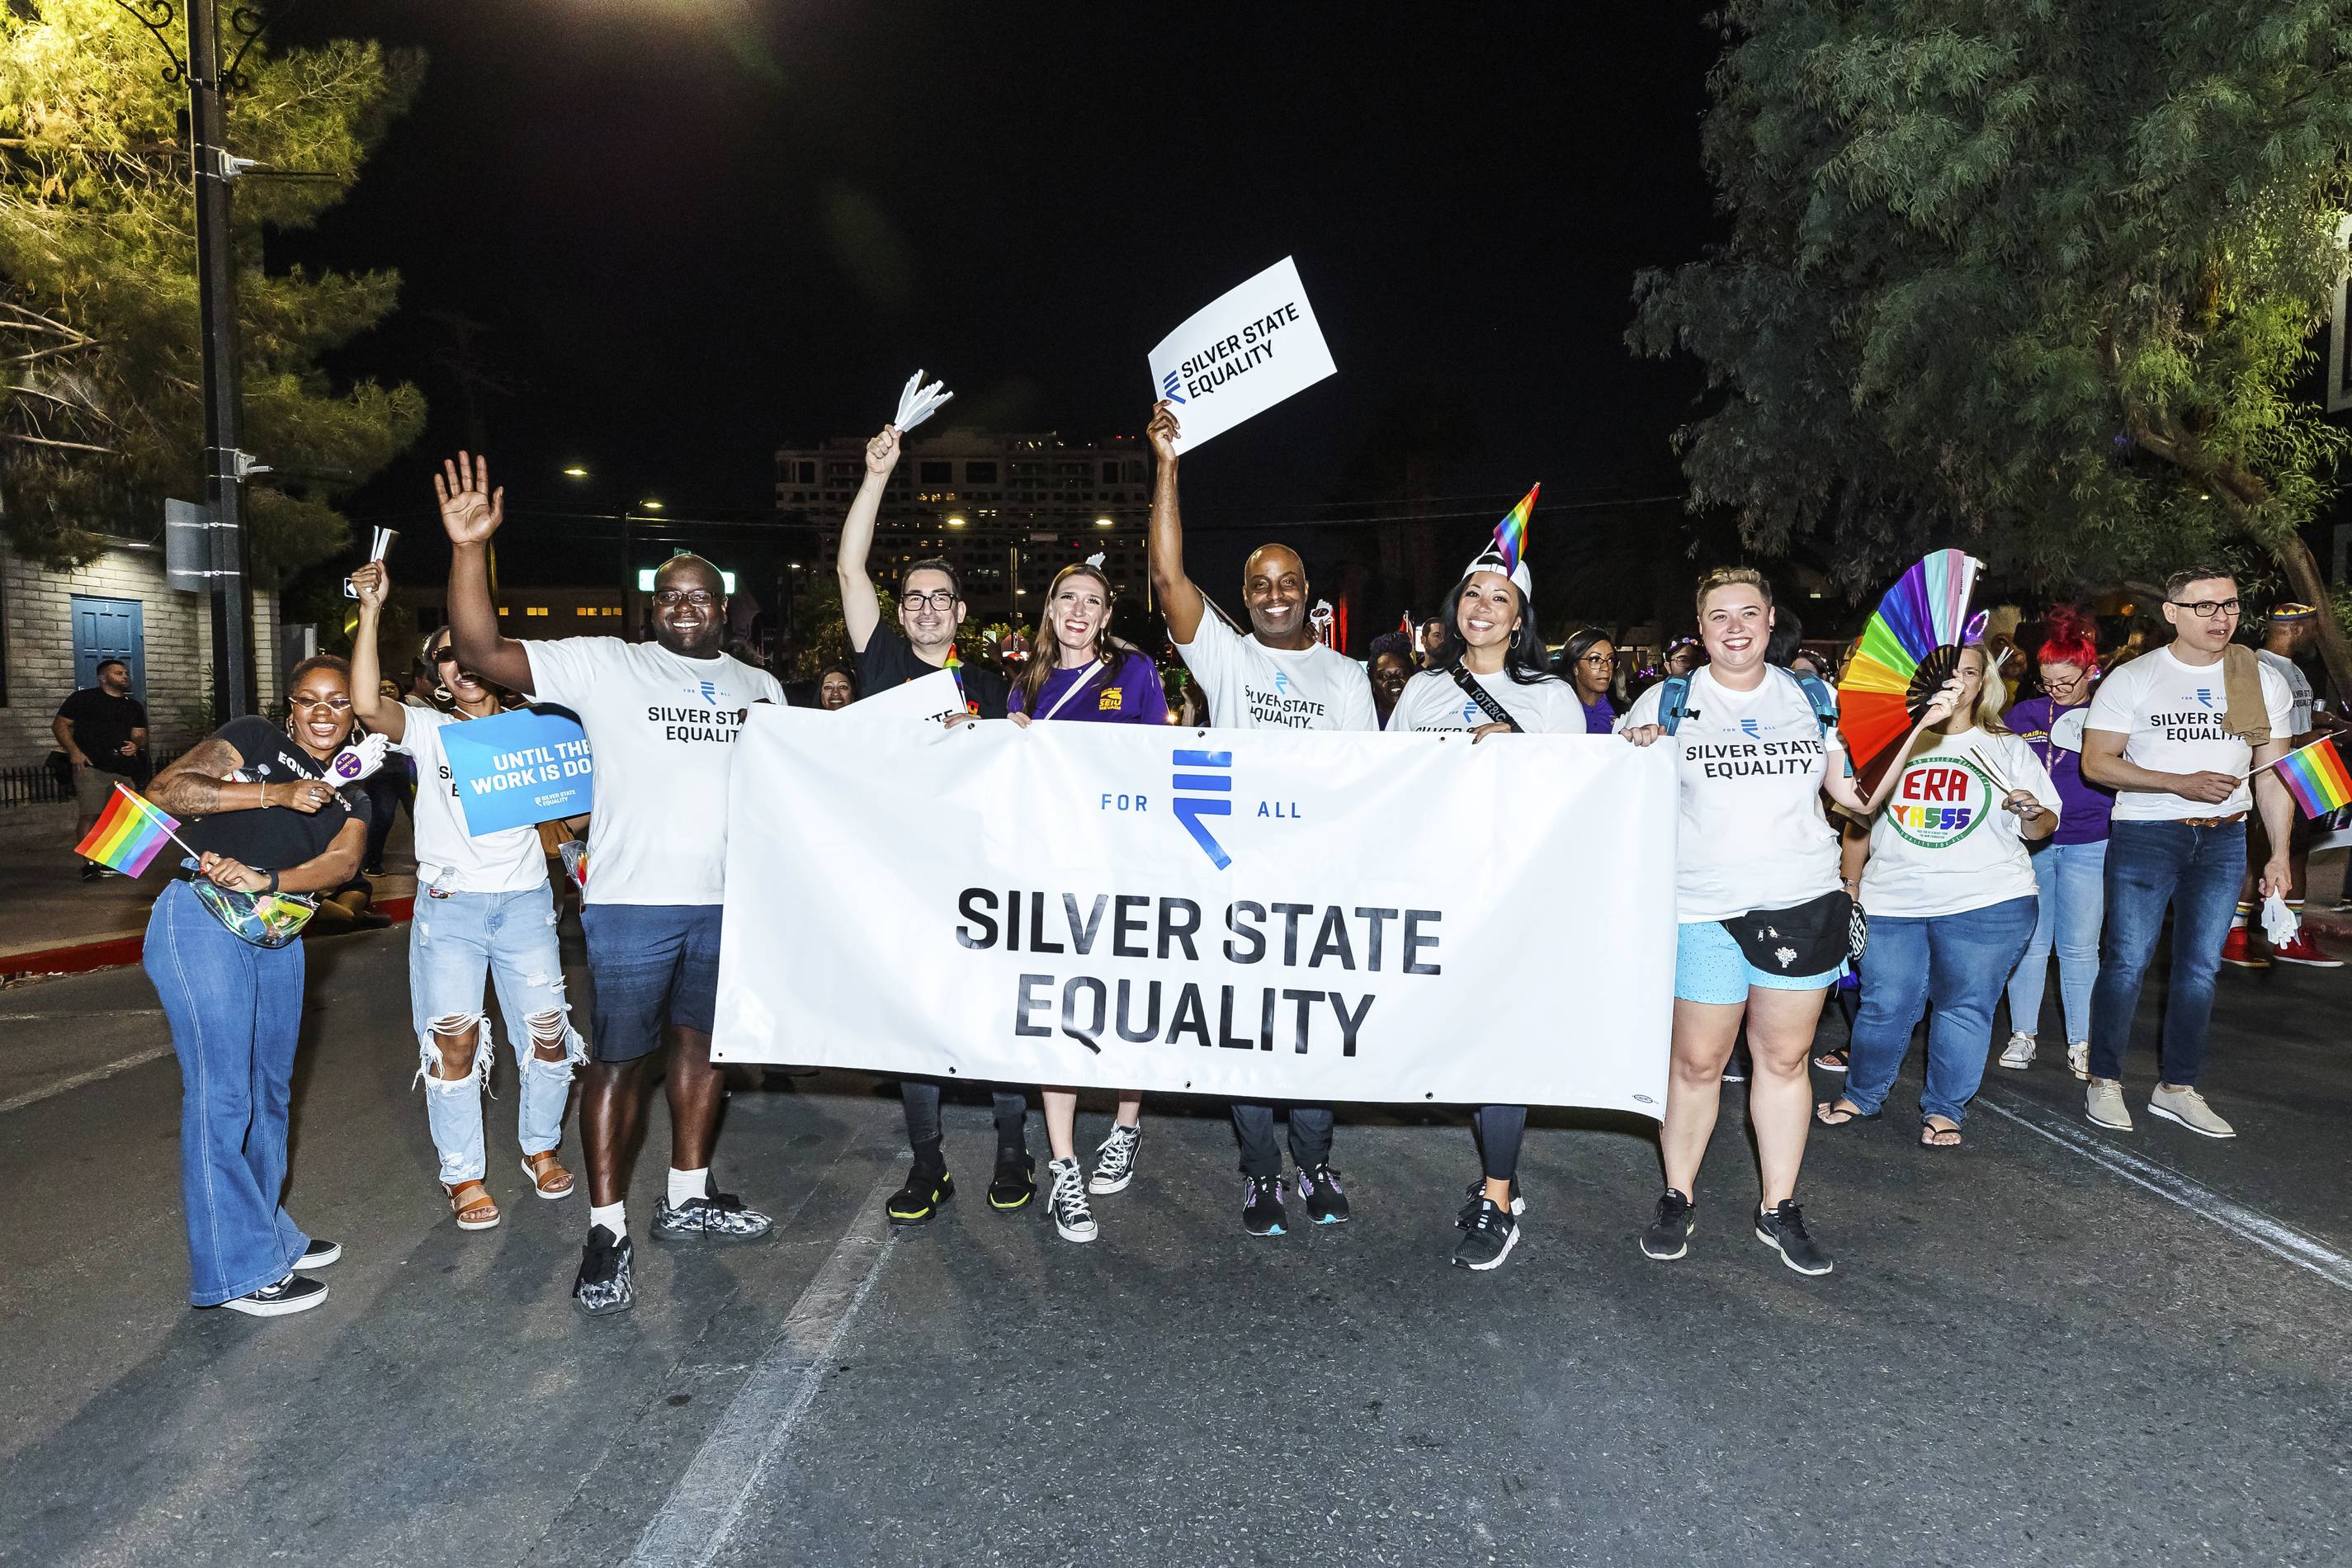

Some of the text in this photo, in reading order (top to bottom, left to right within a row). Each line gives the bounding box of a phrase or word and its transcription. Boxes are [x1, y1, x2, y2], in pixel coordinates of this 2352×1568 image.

[1181, 302, 1300, 379] SILVER STATE
[1187, 339, 1273, 399] EQUALITY
[648, 706, 710, 724] SILVER
[1282, 700, 1325, 716] STATE
[2151, 712, 2208, 726] SILVER
[666, 725, 739, 744] EQUALIT
[492, 739, 591, 772] UNTIL THE
[1686, 740, 1824, 761] SILVER STATE
[277, 751, 320, 781] EQUA
[470, 767, 537, 796] WORK
[539, 763, 560, 782] IS
[563, 758, 593, 777] DO
[1704, 758, 1812, 779] EQUALITY
[541, 789, 576, 801] SILVER STATE
[1903, 768, 1969, 801] ERA
[541, 796, 569, 806] EQUALITY
[1101, 793, 1301, 819] FOR ALL
[1892, 805, 1972, 829] YASSS
[956, 886, 1442, 975] SILVER STATE
[1015, 973, 1376, 1057] EQUALITY
